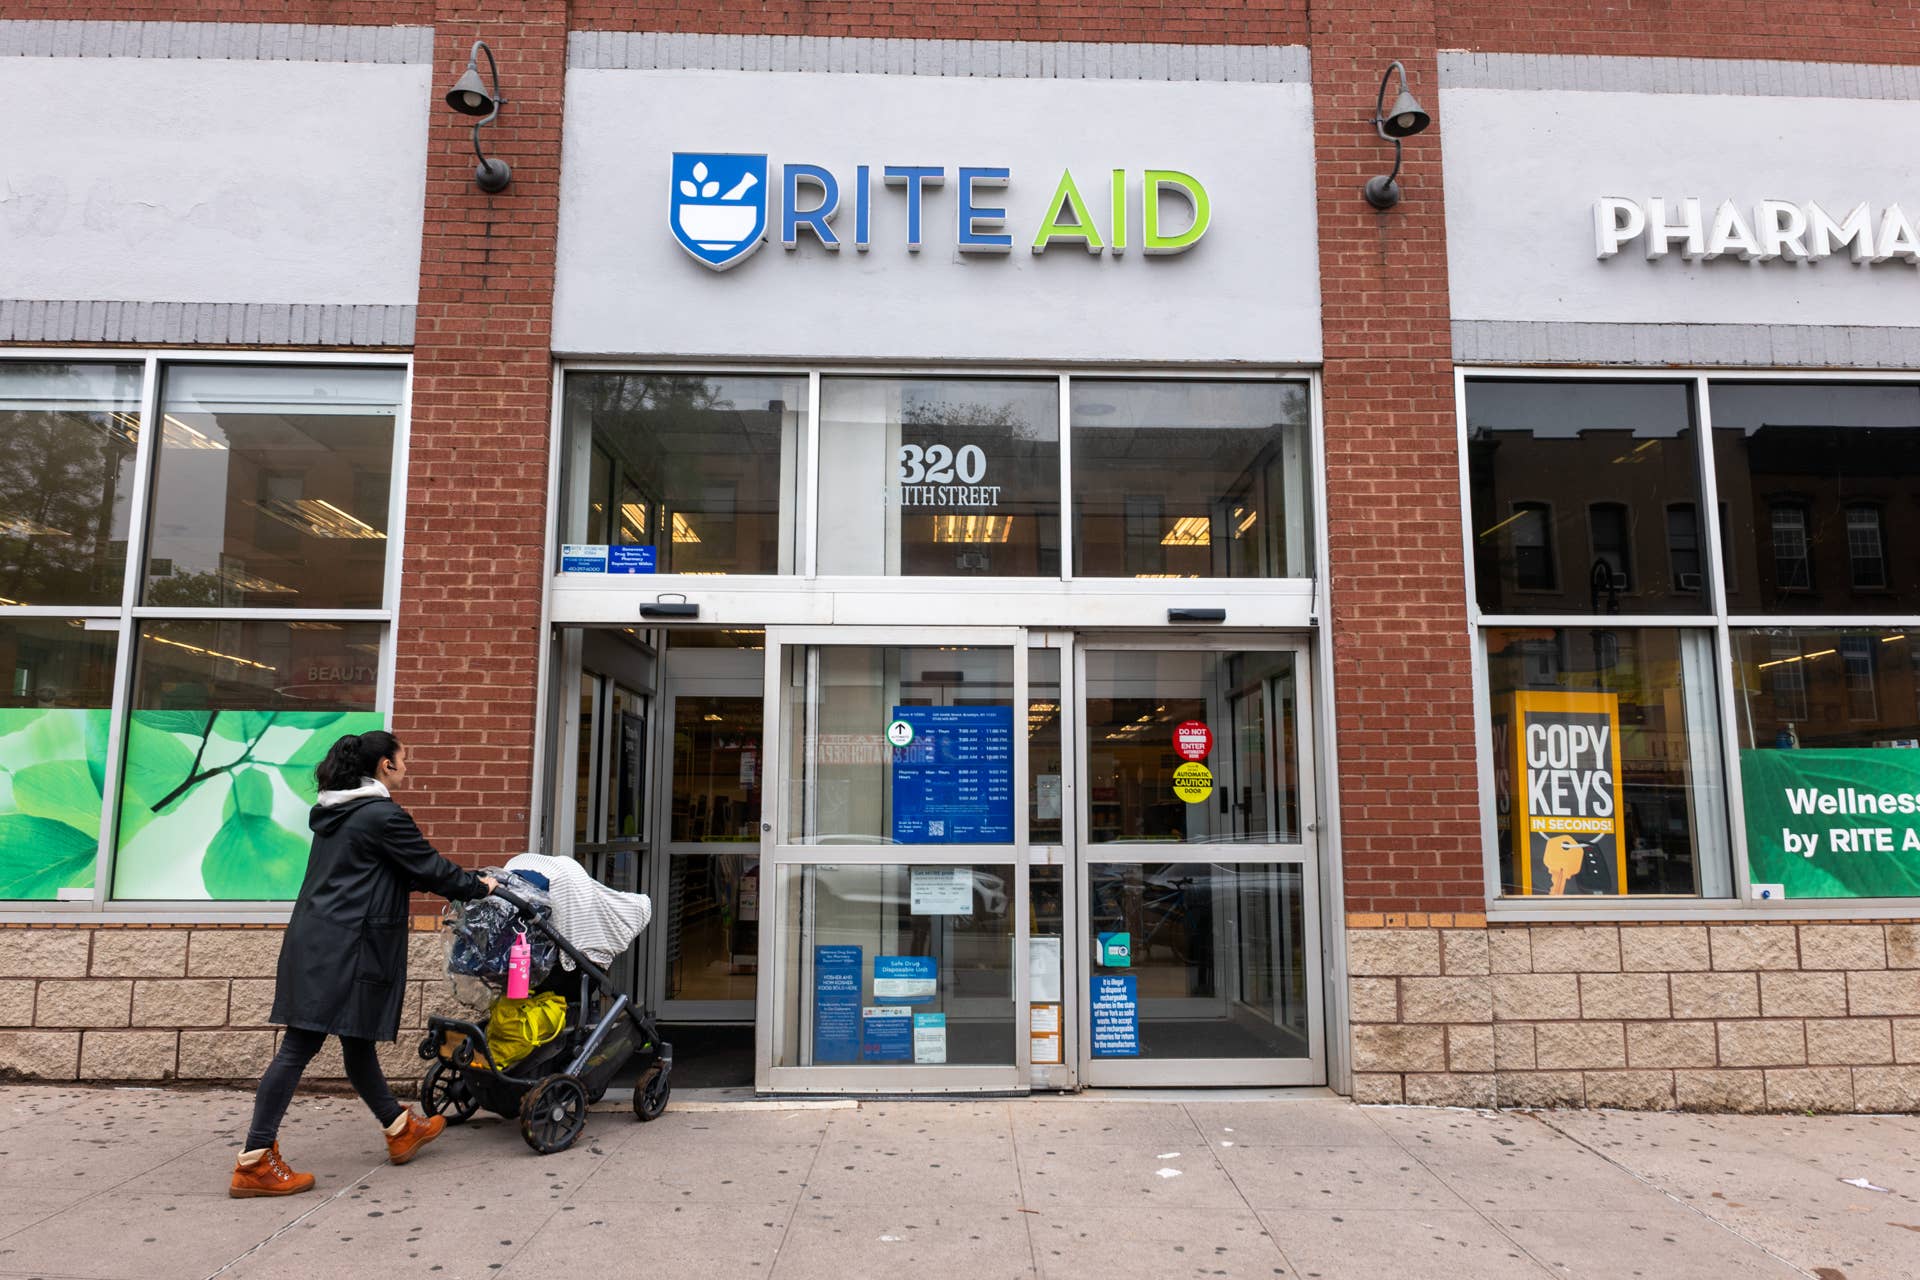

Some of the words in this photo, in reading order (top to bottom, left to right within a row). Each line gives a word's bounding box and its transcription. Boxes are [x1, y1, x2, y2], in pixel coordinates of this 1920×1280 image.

[781, 163, 1014, 253] RITE
[1032, 167, 1212, 255] AID
[1594, 196, 1920, 262] PHARMA
[897, 444, 986, 484] 320
[938, 485, 1001, 506] STREET
[308, 666, 378, 681] BEAUTY
[1526, 723, 1609, 769] COPY
[1175, 778, 1211, 787] CAUTION
[1528, 769, 1614, 817] KEYS
[1785, 788, 1920, 815] Wellnes
[1533, 819, 1546, 830] IN
[1549, 819, 1612, 831] SECONDS!
[1783, 828, 1819, 858] by
[1829, 828, 1894, 852] RITE
